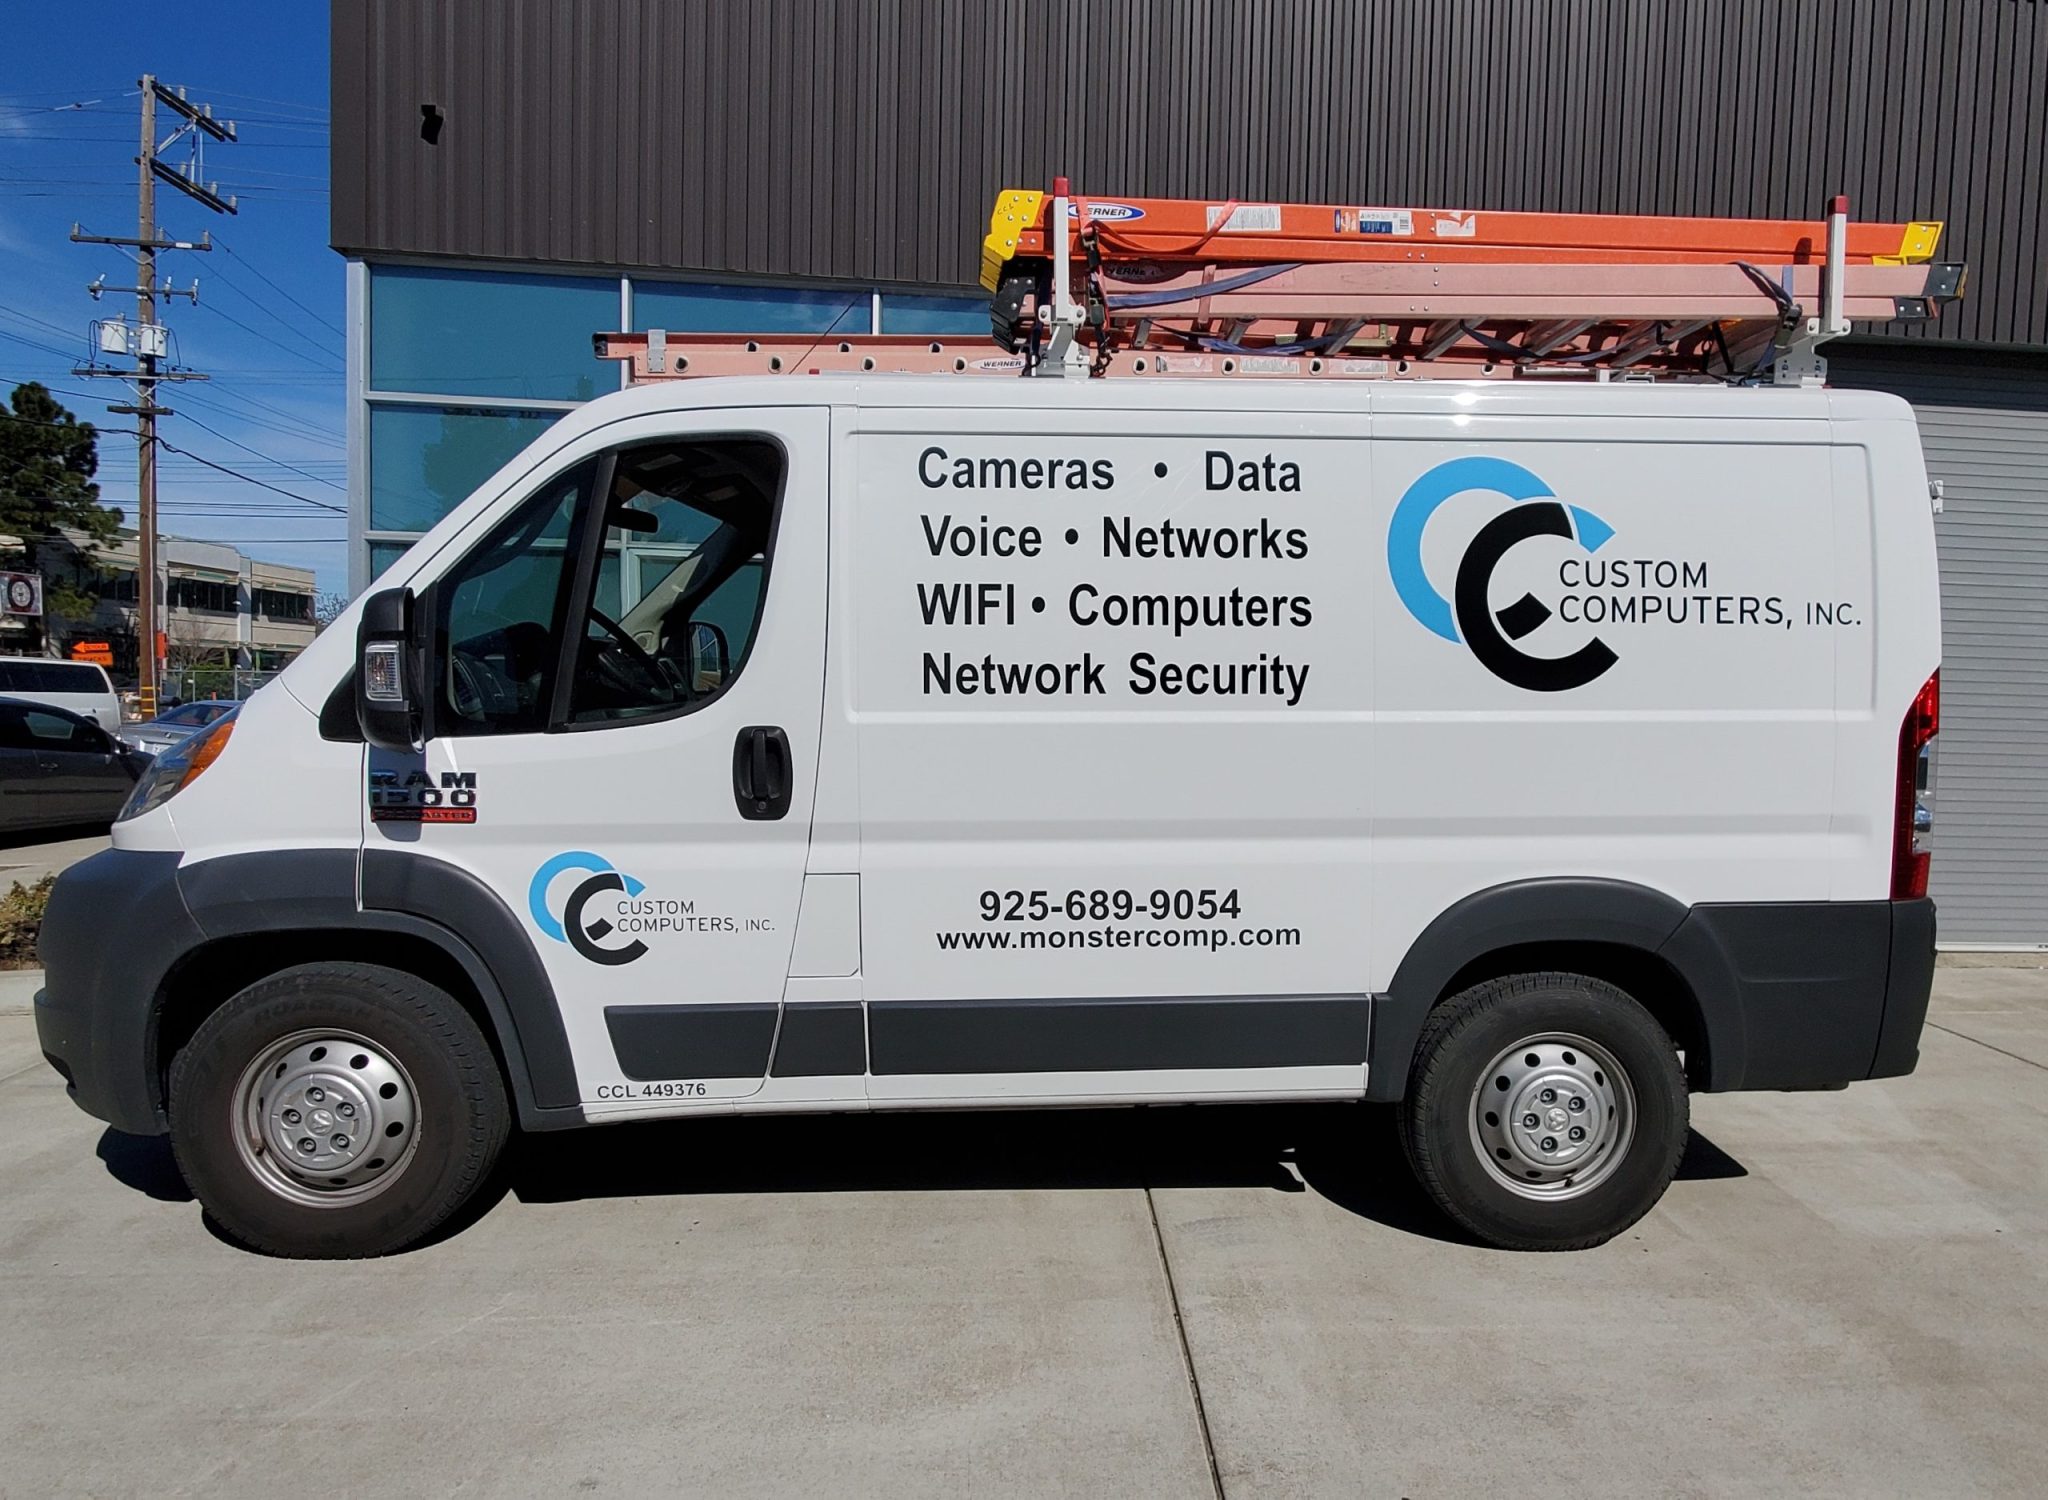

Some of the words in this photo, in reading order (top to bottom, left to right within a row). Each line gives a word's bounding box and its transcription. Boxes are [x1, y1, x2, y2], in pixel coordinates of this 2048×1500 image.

[1079, 207, 1127, 216] ERNER
[983, 360, 1022, 368] WERNER
[918, 446, 1115, 490] Cameras
[1205, 450, 1301, 492] Data
[920, 514, 1042, 558] Voice
[1103, 516, 1309, 559] Networks
[1559, 559, 1707, 589] CUSTOM
[916, 583, 1015, 626] WIFI
[1068, 583, 1313, 637] Computers
[1559, 595, 1793, 629] COMPUTERS,
[1806, 602, 1861, 626] INC.
[923, 652, 1107, 695] Network
[1128, 652, 1310, 707] Security
[371, 770, 477, 789] RAM
[371, 787, 477, 806] 1500
[617, 900, 694, 915] CUSTOM
[979, 889, 1242, 921] 925-689-9054
[617, 917, 739, 934] COMPUTERS,
[745, 919, 775, 931] INC.
[936, 925, 1301, 952] www.monstercomp.com
[597, 1084, 637, 1099] CCL
[642, 1082, 706, 1097] 449376
